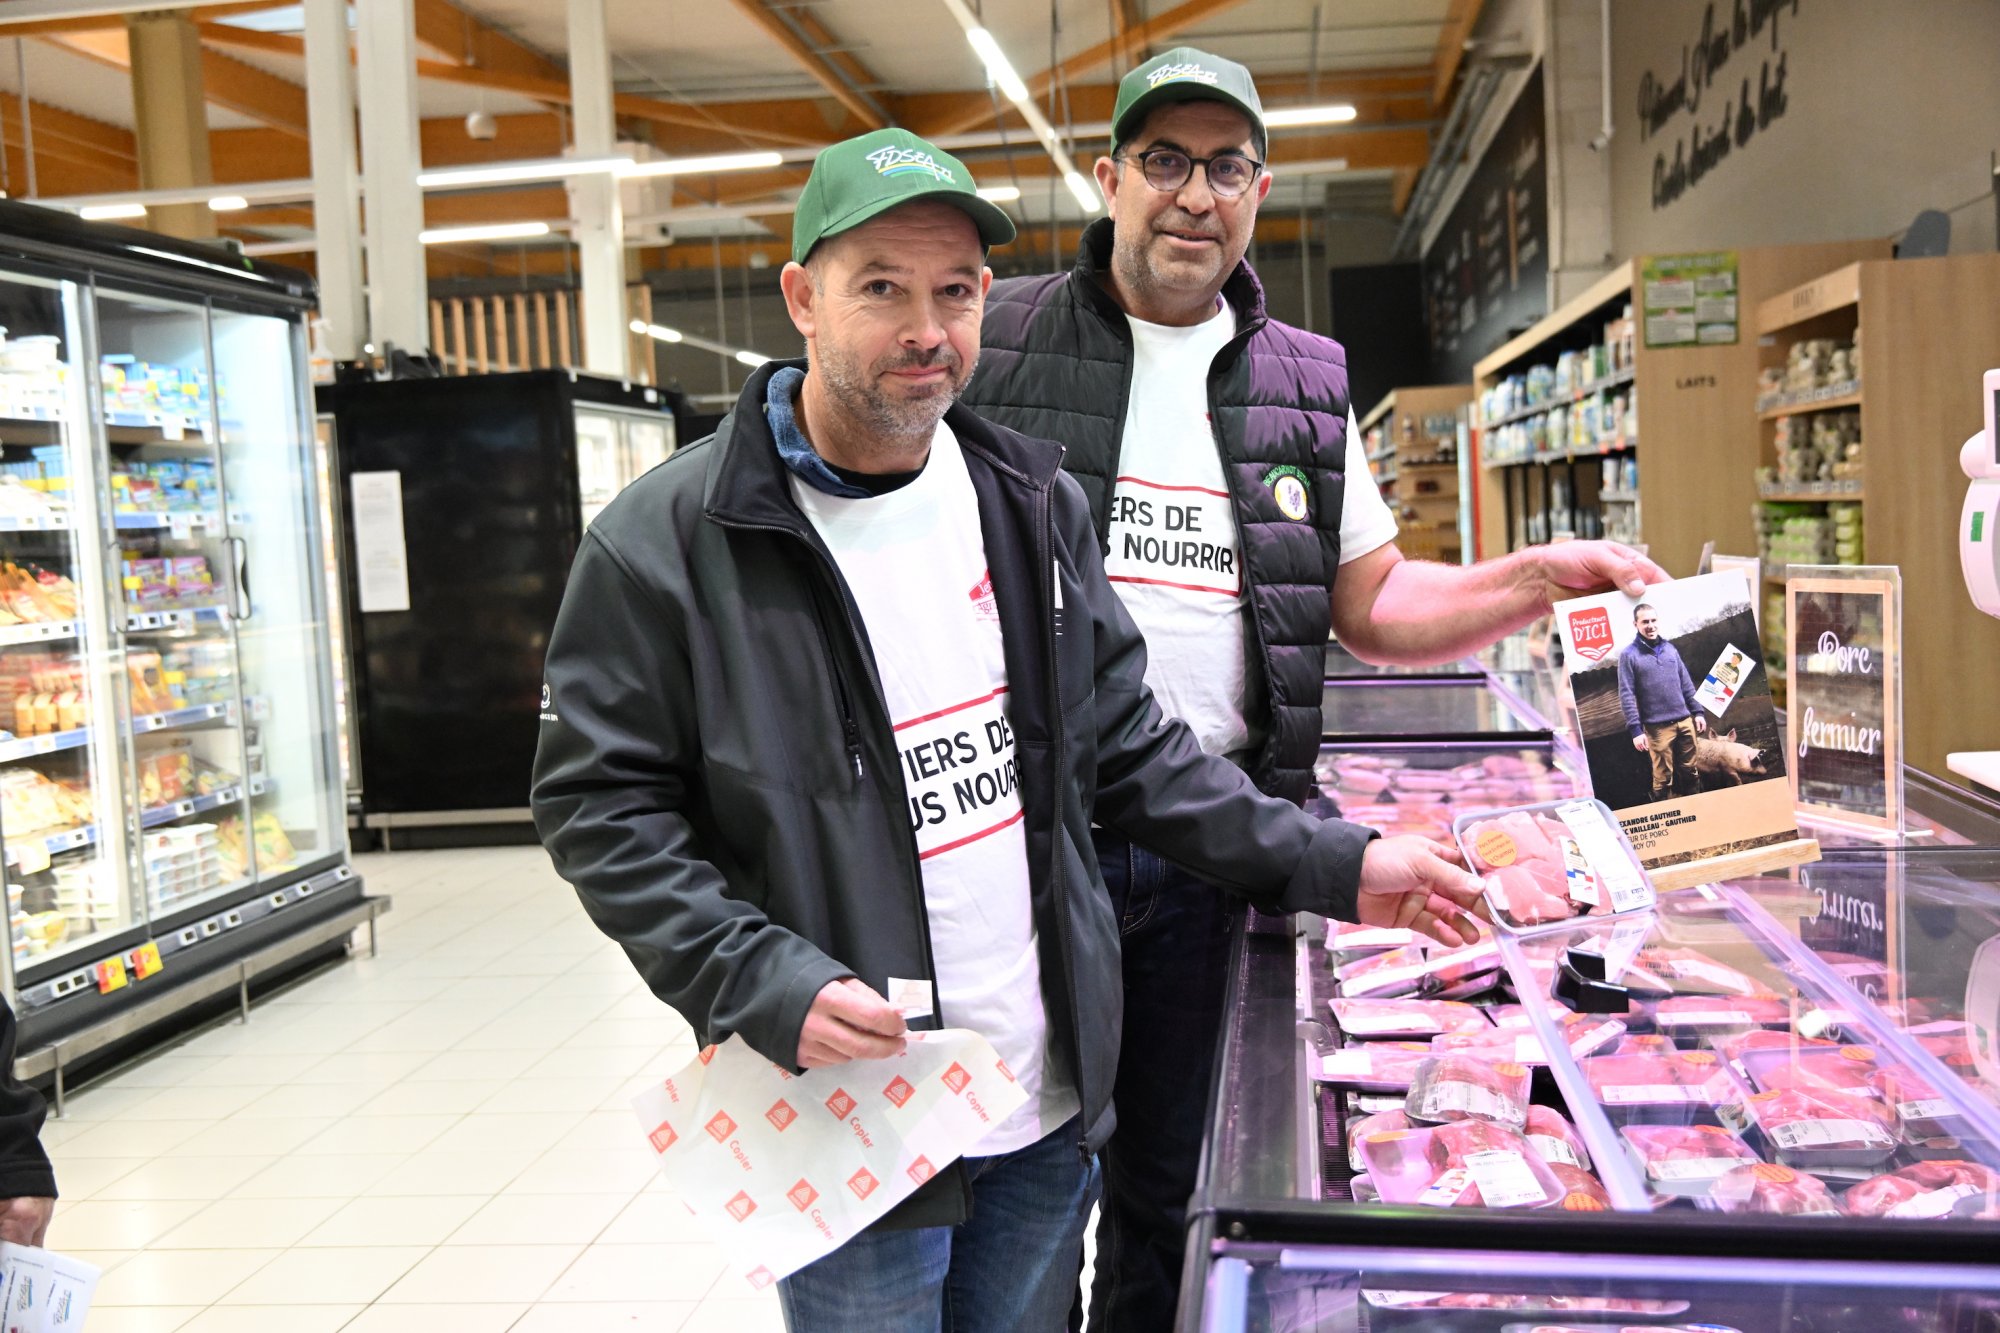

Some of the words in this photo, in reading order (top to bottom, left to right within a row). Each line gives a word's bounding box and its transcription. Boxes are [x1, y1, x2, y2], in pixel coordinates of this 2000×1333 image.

[866, 146, 940, 181] FDSEA
[1676, 376, 1716, 390] LAITS
[1165, 505, 1202, 532] DE
[1123, 532, 1234, 575] NOURRIR
[1572, 615, 1606, 627] Producteurs
[1573, 623, 1608, 642] D'ICI
[1817, 630, 1872, 674] Porc
[984, 715, 1013, 755] DE
[1799, 706, 1881, 758] fermier
[1630, 822, 1660, 834] VAILLEAU
[1665, 815, 1697, 827] GAUTHIER
[1650, 810, 1681, 822] GAUTHIER
[1649, 829, 1669, 839] PORCS
